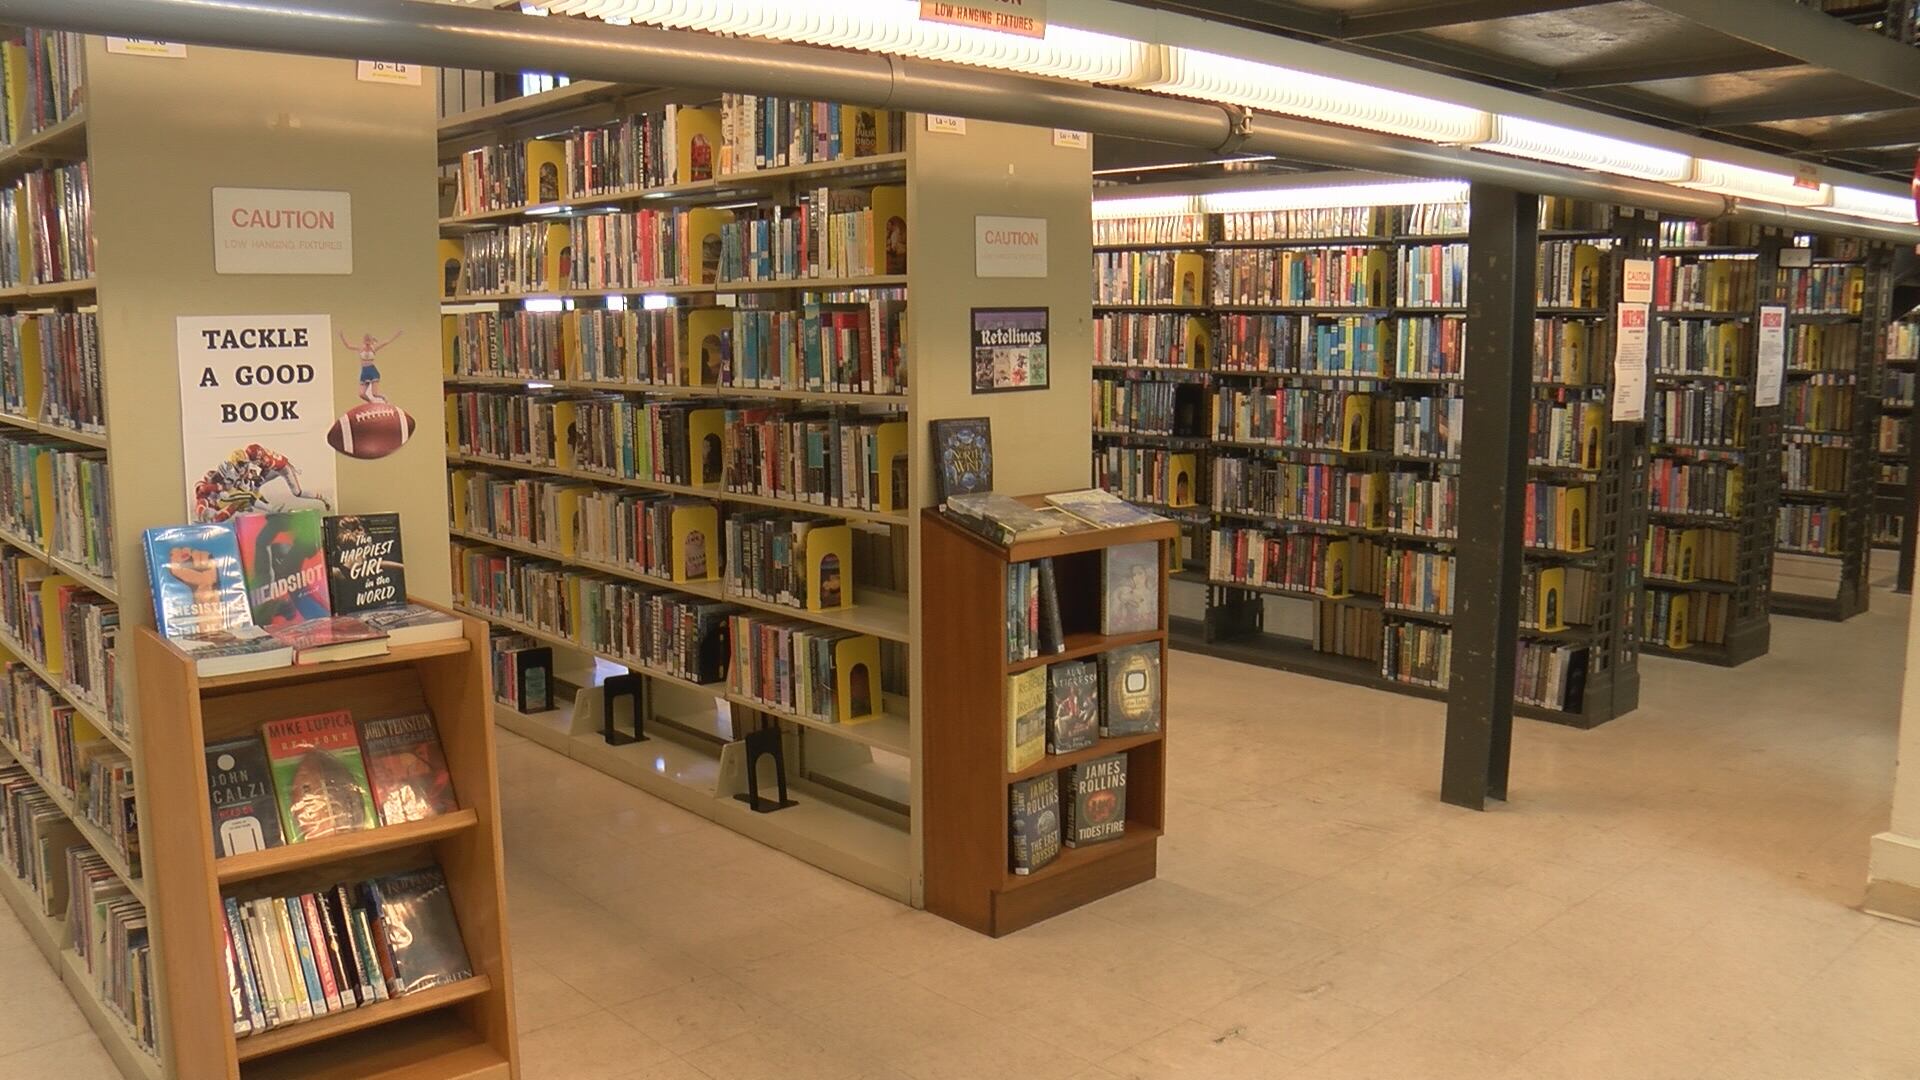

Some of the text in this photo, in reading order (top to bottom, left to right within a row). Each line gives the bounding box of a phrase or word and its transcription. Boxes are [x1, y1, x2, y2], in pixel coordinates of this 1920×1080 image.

[935, 3, 1034, 31] LOW HANGING FIXTURES
[231, 207, 335, 230] CAUTION
[224, 239, 343, 251] LOW HANGING FIXTURES
[984, 229, 1039, 246] CAUTION
[202, 328, 309, 350] TACKLE
[980, 327, 1042, 347] Retellings
[199, 364, 315, 387] A GOOD
[221, 400, 299, 423] BOOK
[355, 533, 373, 546] The
[340, 540, 395, 564] HAPPIEST
[350, 557, 384, 580] GIRL
[250, 563, 323, 608] HEADSHOT
[365, 575, 391, 589] in the
[356, 585, 396, 606] WORLD
[268, 713, 353, 738] MIKE LUPICA
[364, 719, 388, 740] JOHN
[211, 769, 249, 788] JOHN
[1085, 760, 1120, 780] JAMES
[211, 781, 266, 805] CALZI
[1030, 777, 1055, 800] JAMES
[1079, 773, 1126, 794] ROLLINS
[1026, 789, 1059, 816] ROLLINS
[1079, 824, 1101, 840] TIDES
[1106, 820, 1125, 834] FIRE
[1031, 840, 1043, 853] THE
[1044, 830, 1058, 847] LAST
